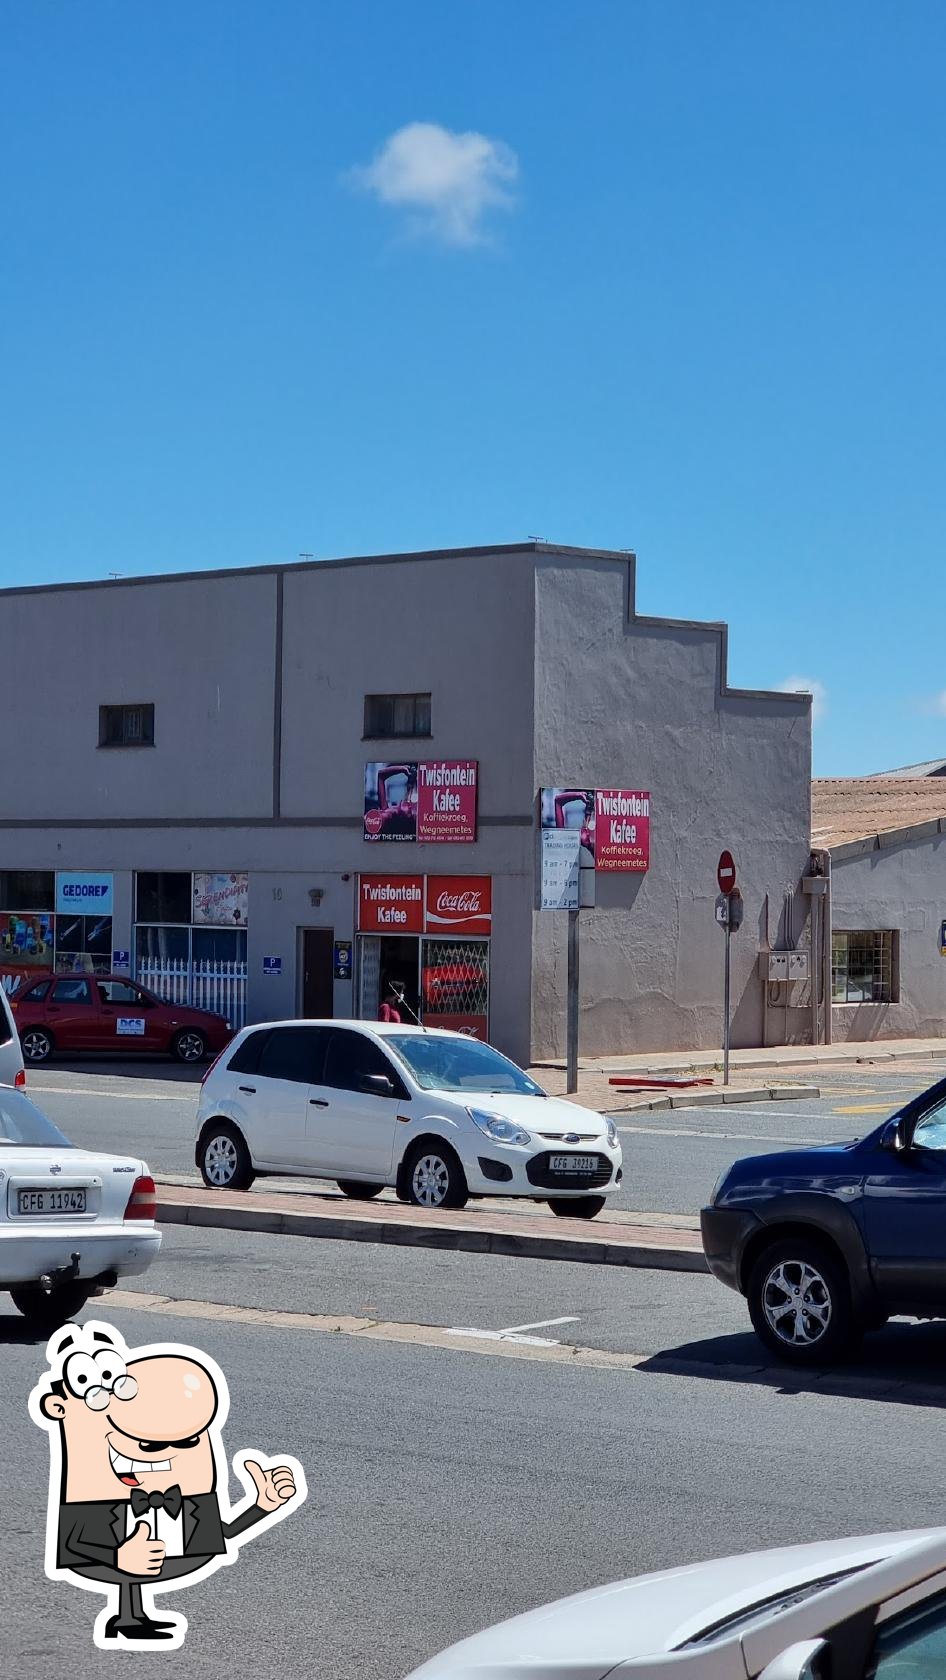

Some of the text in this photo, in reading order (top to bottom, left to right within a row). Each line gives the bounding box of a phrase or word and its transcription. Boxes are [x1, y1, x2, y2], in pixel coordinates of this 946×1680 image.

[419, 763, 476, 787] Twisfontein
[433, 790, 461, 812] Kafee
[596, 791, 650, 817] Twisfontein
[419, 826, 472, 835] Wegneemetes
[610, 818, 637, 845] Kafee
[601, 846, 644, 856] Koffiekroeg,
[597, 858, 648, 868] Wegneemetes
[63, 884, 101, 897] GEDORE
[363, 883, 421, 901] Twisfontein
[568, 880, 578, 888] pm
[437, 891, 481, 911] Coca-Cola
[543, 898, 548, 906] 9
[568, 899, 578, 907] pm
[377, 906, 407, 923] Kafee
[553, 1157, 567, 1169] CFG
[22, 1192, 84, 1210] CFG 11942
